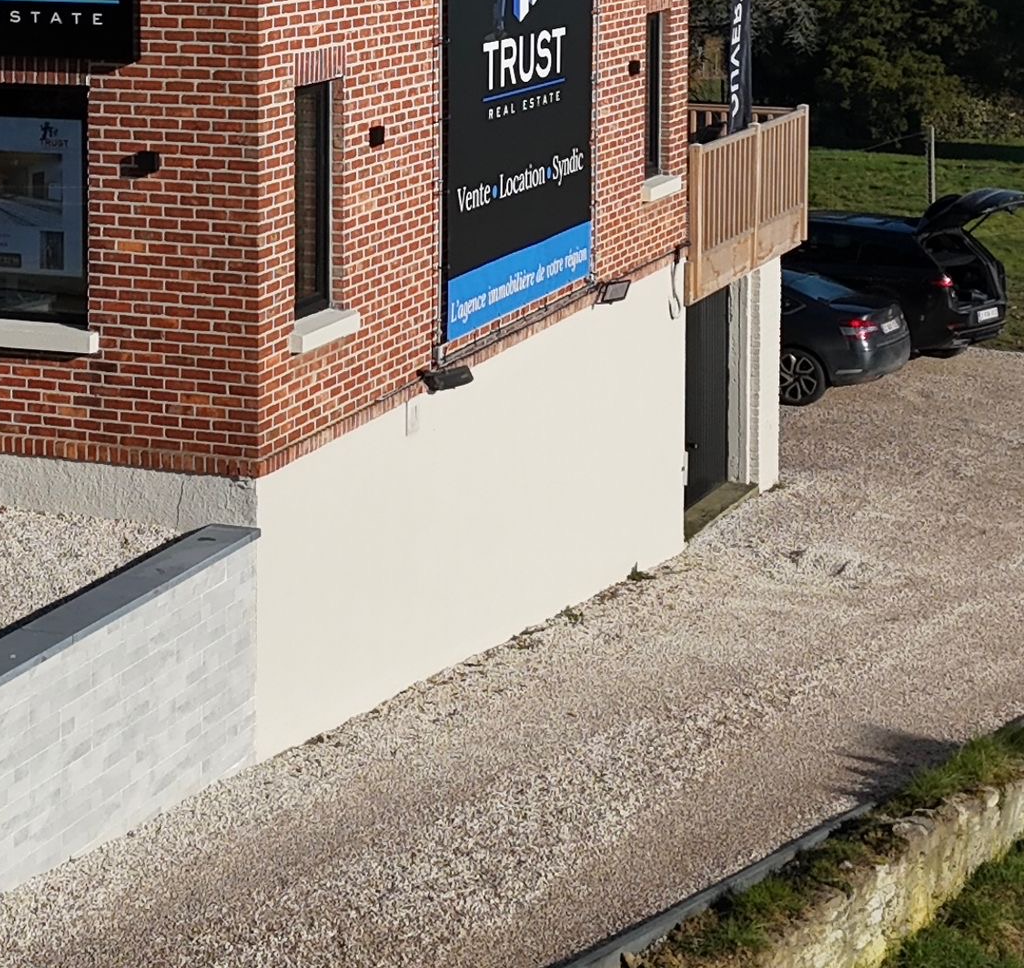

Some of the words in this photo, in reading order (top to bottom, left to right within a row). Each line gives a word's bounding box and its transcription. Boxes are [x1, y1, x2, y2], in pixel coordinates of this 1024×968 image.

[483, 27, 566, 91] TRUST
[488, 103, 516, 120] REAL
[522, 90, 561, 111] ESTATE
[457, 182, 491, 213] Vente
[498, 164, 545, 199] Location
[552, 147, 584, 186] Syndic
[450, 292, 487, 324] L'agence
[487, 269, 536, 306] immobilière
[536, 263, 546, 283] de
[546, 257, 564, 279] votre
[564, 247, 587, 272] région
